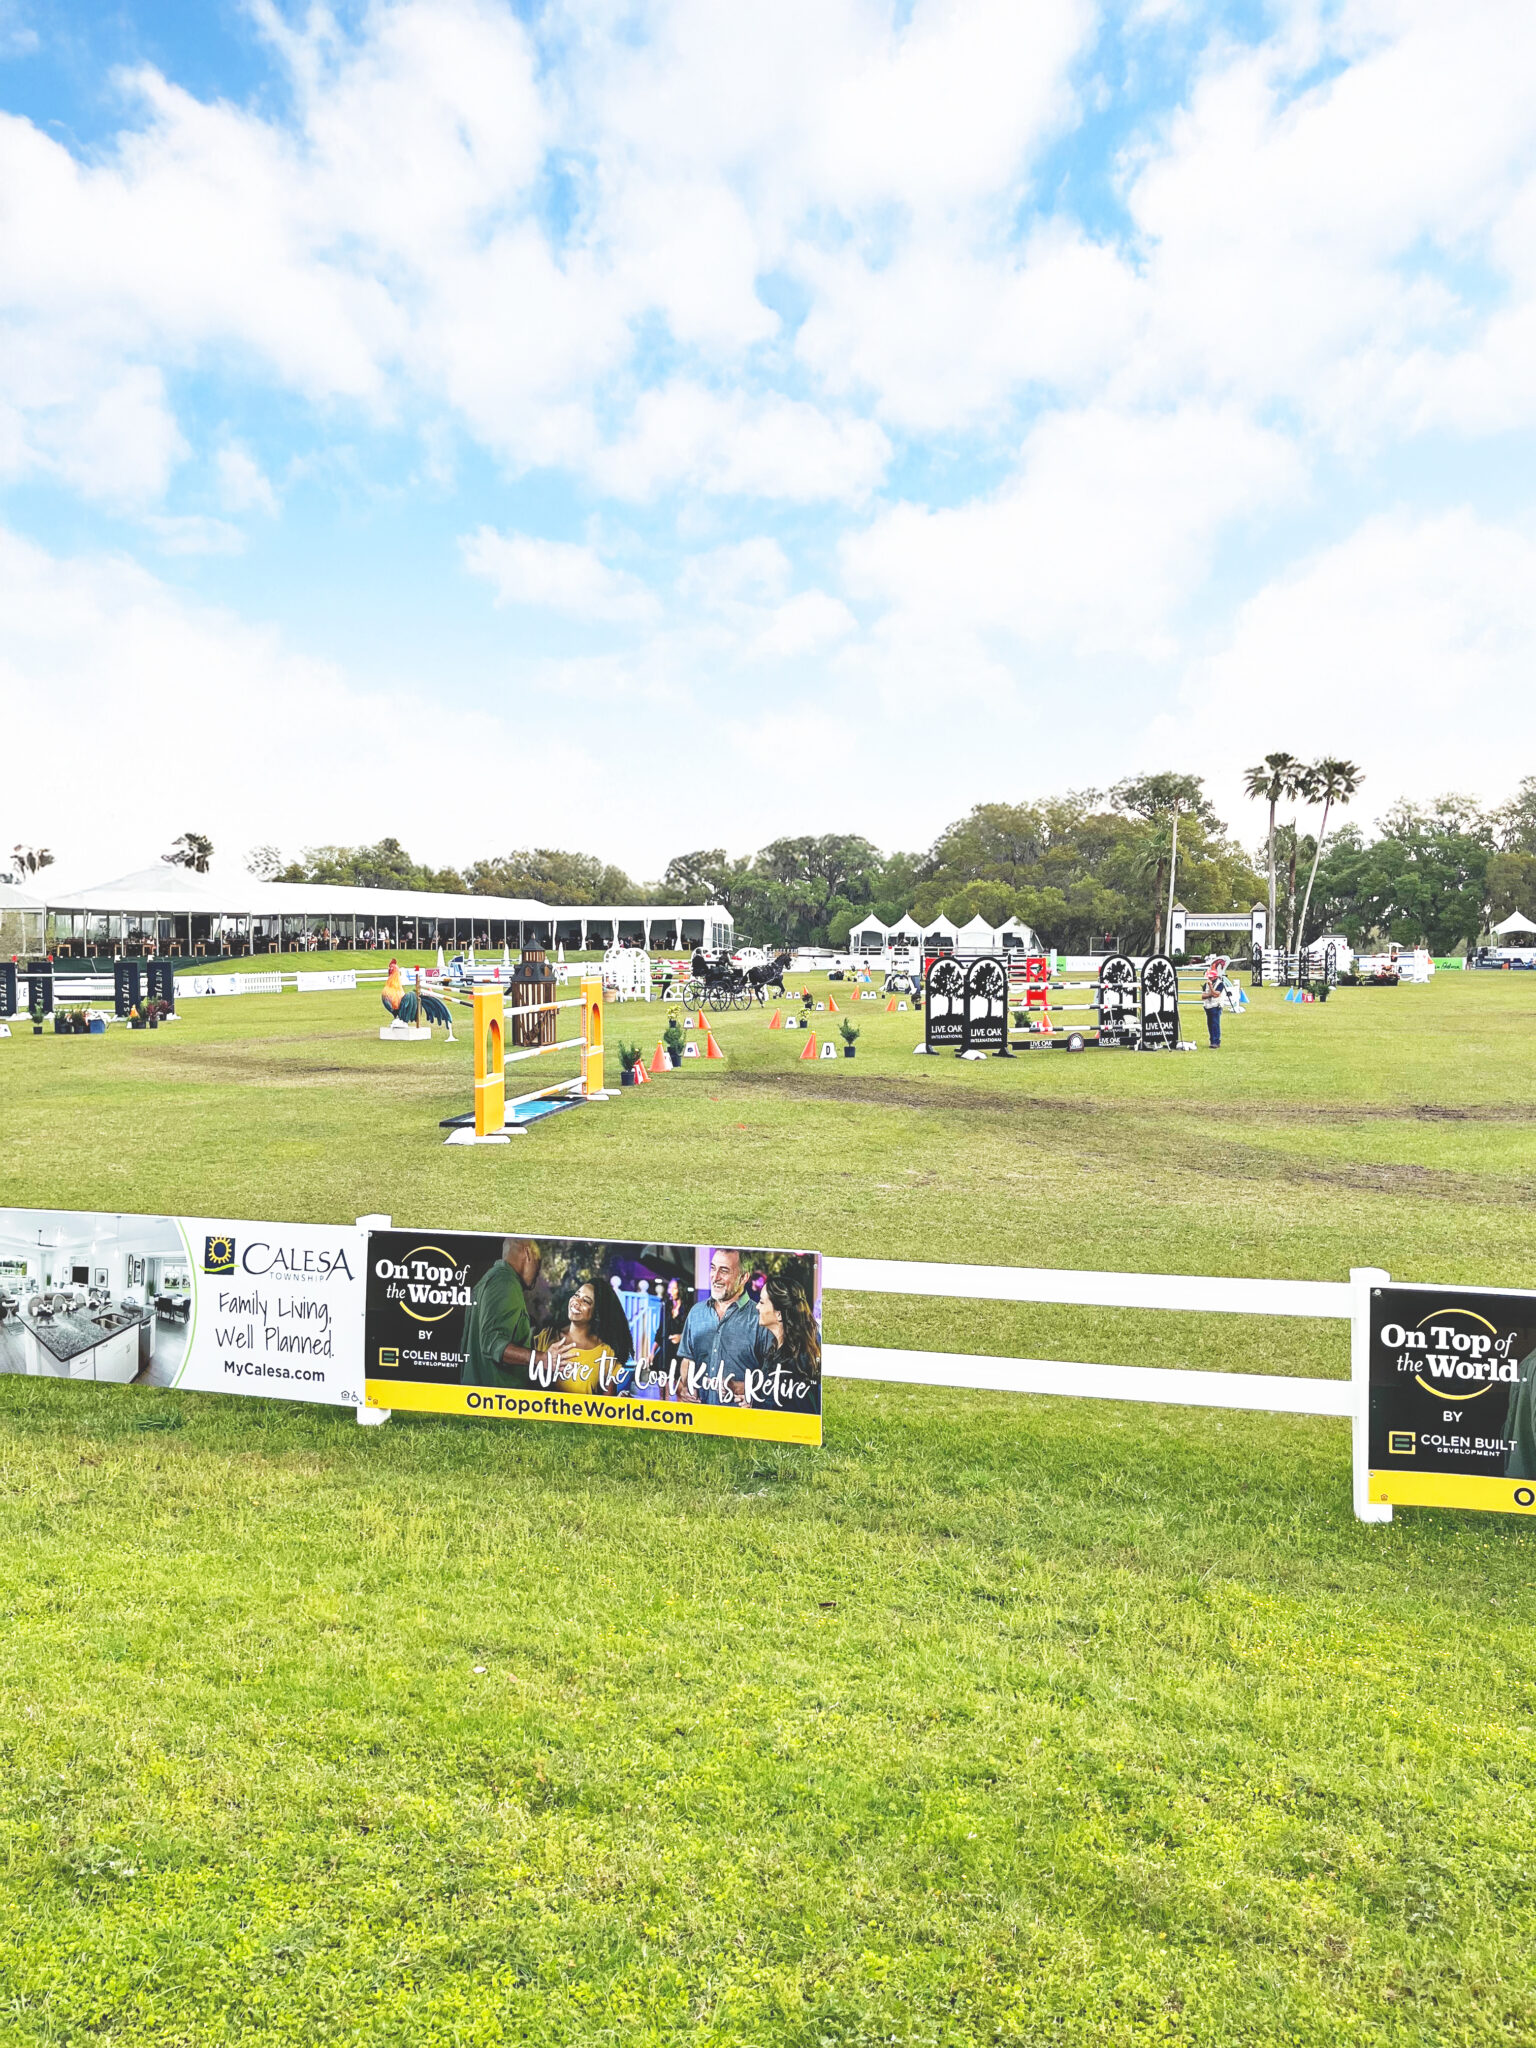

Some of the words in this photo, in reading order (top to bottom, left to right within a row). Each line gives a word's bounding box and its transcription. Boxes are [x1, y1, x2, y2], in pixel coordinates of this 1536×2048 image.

[327, 974, 355, 984] NETJETS
[931, 1025, 946, 1033] LIVE
[947, 1024, 963, 1032] OAK
[970, 1029, 985, 1037] LIVE
[986, 1028, 1002, 1036] OAK
[1145, 1022, 1158, 1030] LIVE
[242, 1242, 356, 1281] CALESA
[269, 1271, 325, 1282] TOWNSHIP
[375, 1259, 409, 1279] On
[411, 1261, 453, 1286] Top
[455, 1264, 470, 1286] of
[386, 1283, 406, 1299] the
[407, 1283, 477, 1306] World.
[218, 1290, 268, 1336] Family
[278, 1295, 332, 1333] Living,
[215, 1325, 254, 1350] Well
[265, 1326, 335, 1358] Planned.
[418, 1330, 433, 1340] BY
[1380, 1323, 1428, 1348] On
[1430, 1326, 1491, 1359] Top
[1494, 1332, 1517, 1359] of
[402, 1350, 438, 1361] COLEN
[440, 1352, 470, 1363] BUILT
[413, 1360, 459, 1368] DEVELOPMENT
[224, 1361, 326, 1383] MyCalesa.com
[1396, 1352, 1423, 1373] the
[1425, 1354, 1528, 1383] World.
[528, 1349, 594, 1388] Where
[595, 1350, 629, 1392] the
[634, 1357, 683, 1396] Cool
[687, 1359, 735, 1404] Kids
[466, 1392, 694, 1426] OnTopoftheWorld.com
[1442, 1411, 1463, 1423] BY
[1420, 1434, 1470, 1448] COLEN
[1474, 1437, 1518, 1451] BUILT
[1437, 1447, 1501, 1457] DEVELOPMENT
